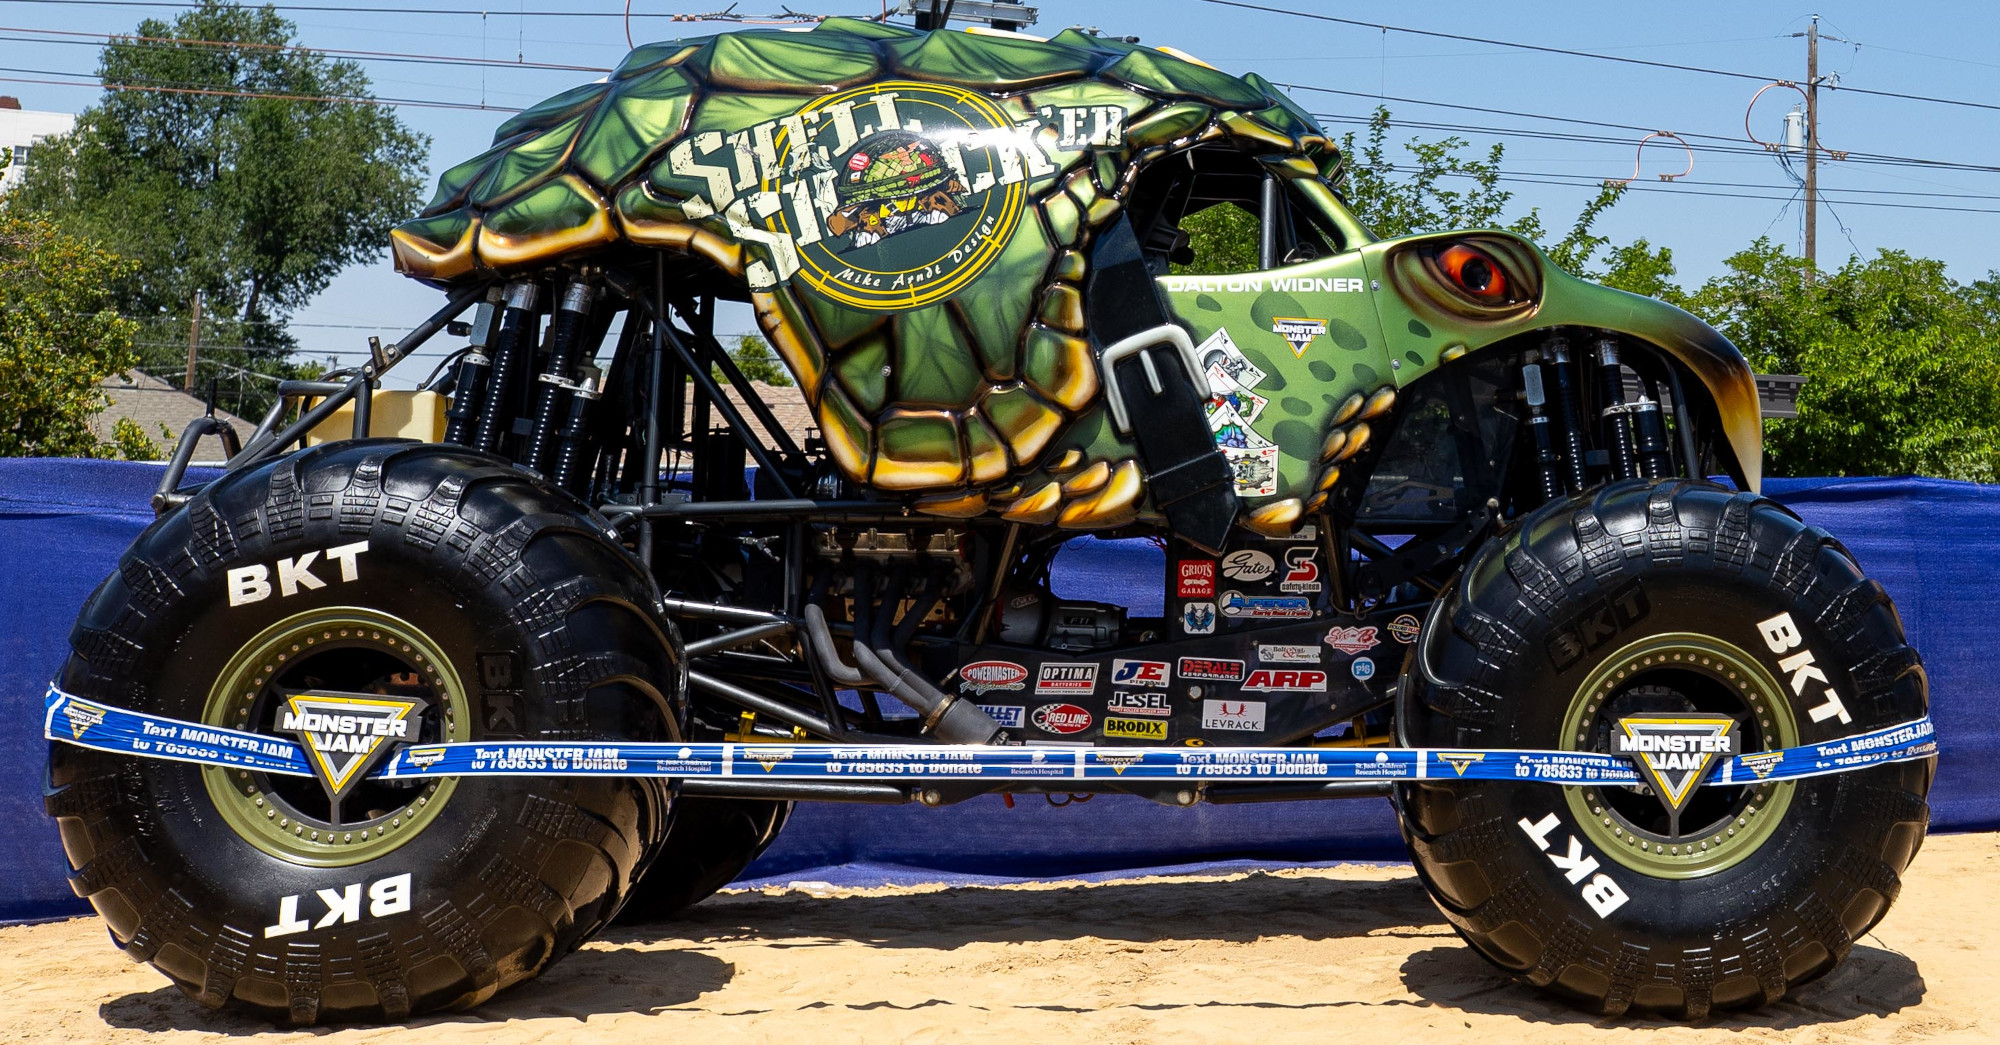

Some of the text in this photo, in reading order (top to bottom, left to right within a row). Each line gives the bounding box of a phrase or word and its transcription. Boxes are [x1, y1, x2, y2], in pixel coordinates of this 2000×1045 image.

[669, 92, 923, 220] SHELL
[834, 215, 995, 290] Mike Arndt Design
[1167, 278, 1364, 293] DALTON WIDNER
[1272, 325, 1327, 335] MONSTER
[1286, 333, 1313, 342] JAM
[1181, 563, 1213, 577] GRIOT'S
[1223, 553, 1275, 578] Gates
[227, 541, 369, 607] BKT
[1229, 597, 1308, 608] SUPERIOR
[1551, 585, 1641, 669] BKT
[967, 666, 1020, 681] POWERMASTER
[1043, 667, 1093, 680] OPTIMA
[1115, 662, 1166, 682] JE
[1183, 659, 1240, 675] DERALE
[1355, 663, 1371, 674] pig
[1757, 611, 1852, 725] BKT
[1182, 672, 1239, 680] PERFORMANCE
[1245, 671, 1326, 688] ARP
[1108, 692, 1171, 708] JESEL
[978, 707, 1022, 720] ULLET
[1049, 713, 1067, 723] RED
[283, 711, 407, 737] MONSTER
[1107, 720, 1162, 735] BRODIX
[315, 733, 372, 753] JAM
[1620, 735, 1731, 752] MONSTER
[572, 758, 628, 771] Donate
[1180, 752, 1211, 764] Text
[1652, 752, 1703, 770] JAM
[1039, 768, 1064, 776] Hospital
[1276, 763, 1328, 775] Donate
[1515, 763, 1530, 777] to
[1534, 763, 1583, 778] 785833
[1517, 812, 1630, 919] BKT
[264, 873, 411, 939] BKT
